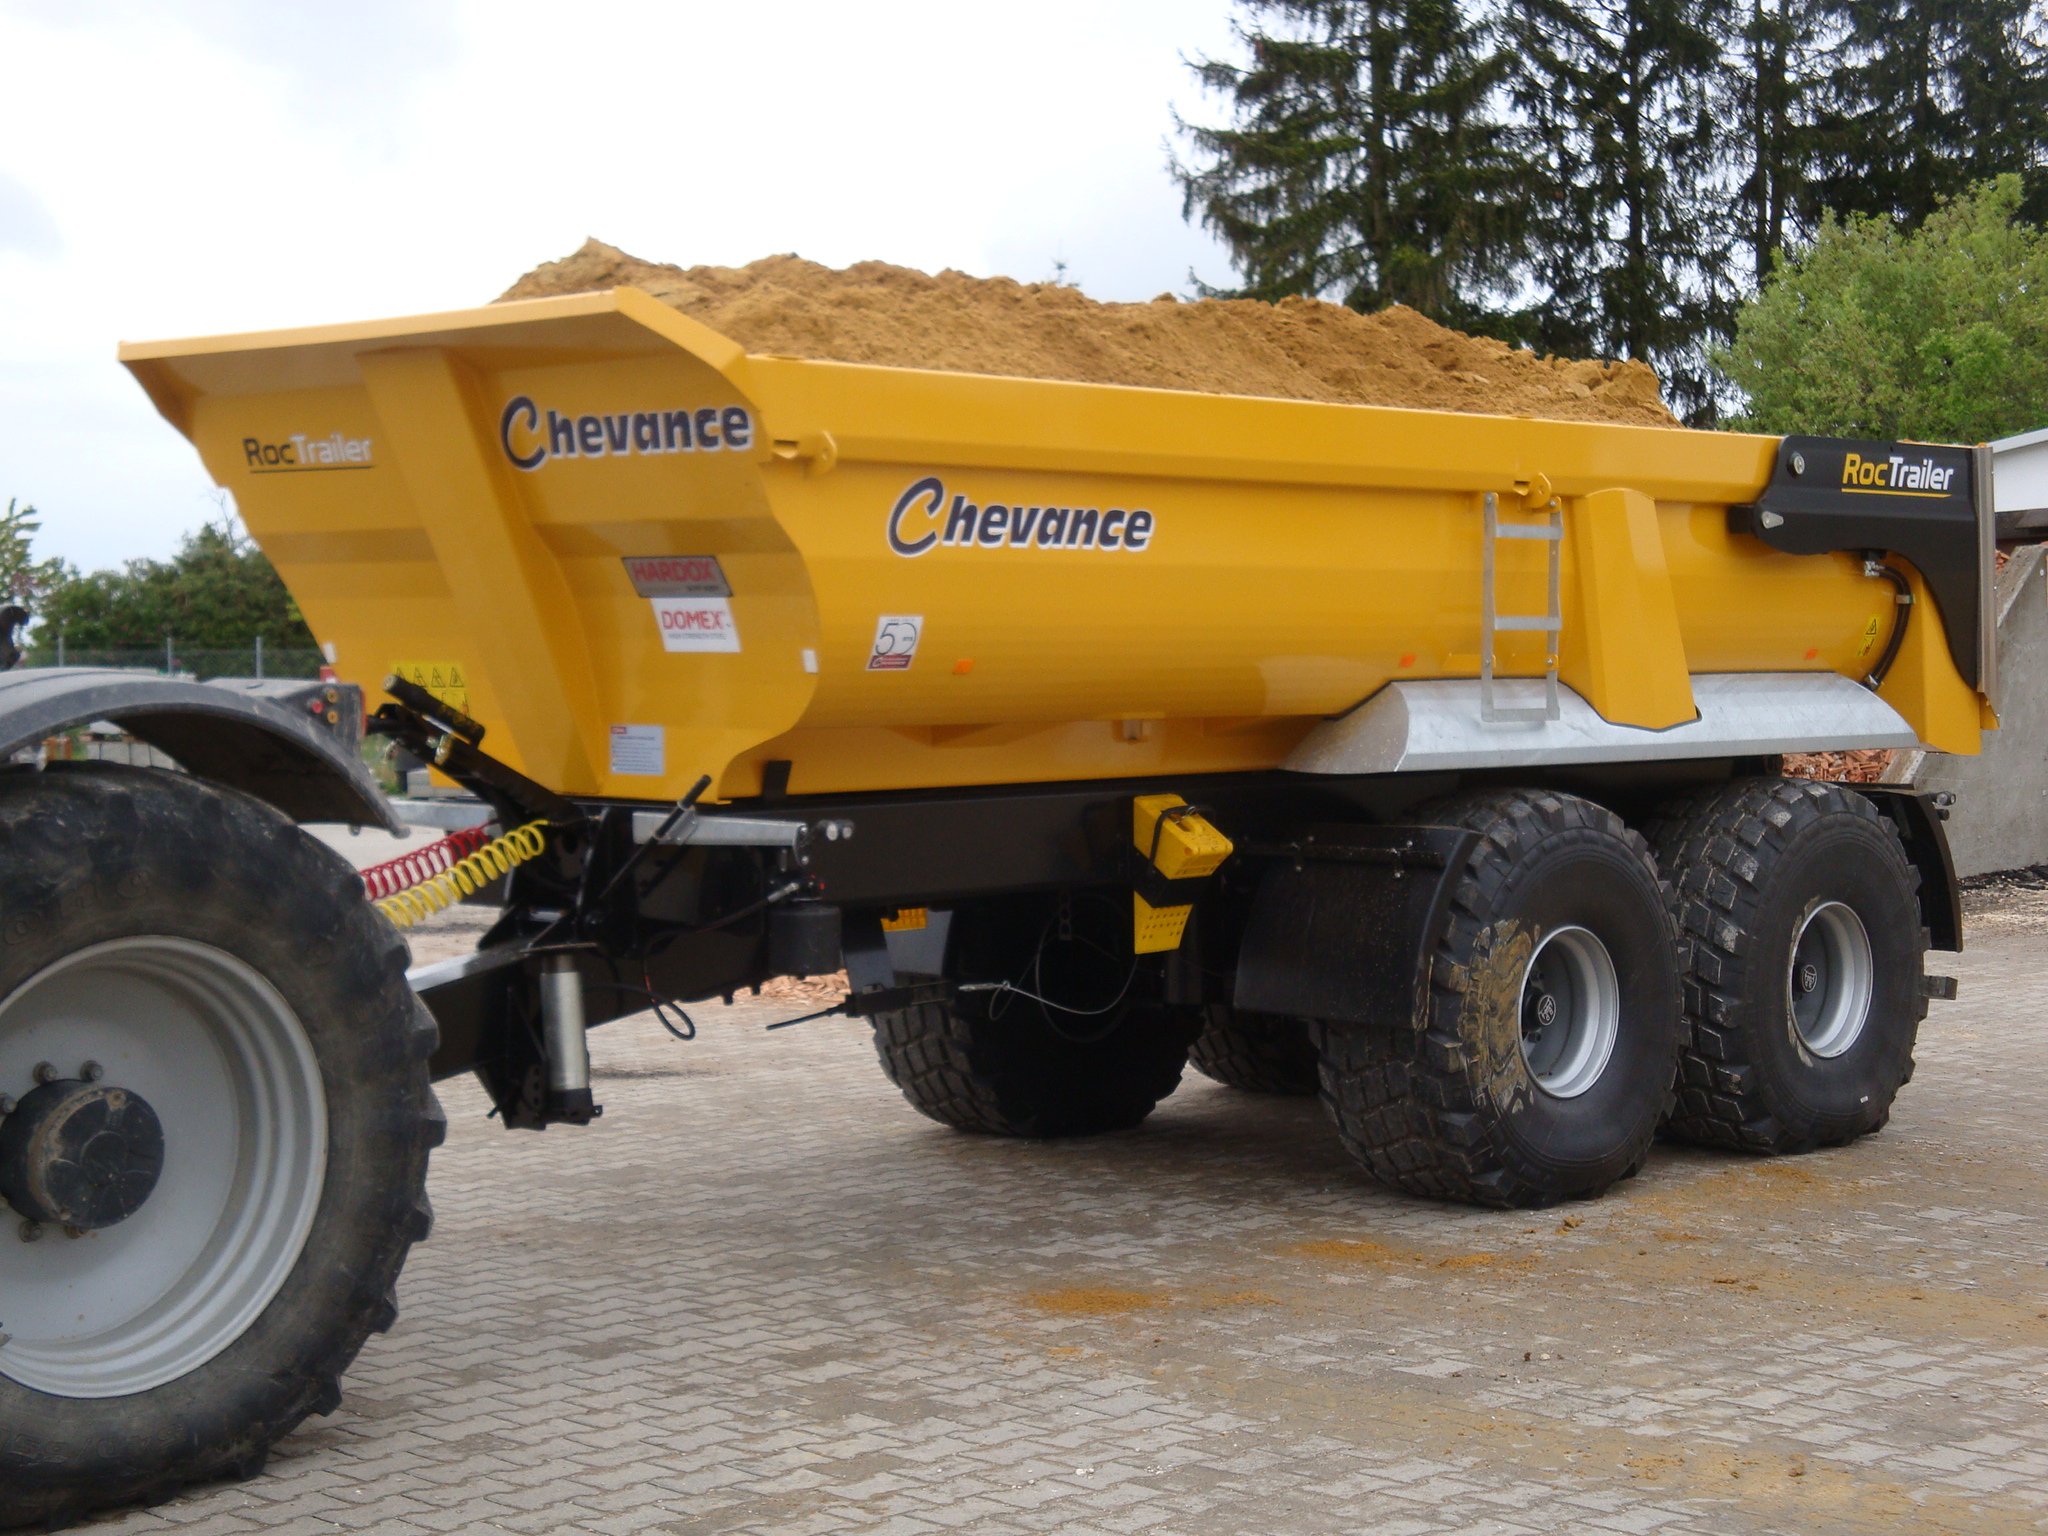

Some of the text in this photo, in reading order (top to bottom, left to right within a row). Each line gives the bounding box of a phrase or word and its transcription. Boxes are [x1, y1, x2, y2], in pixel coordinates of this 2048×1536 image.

[242, 433, 372, 466] RocTrailer
[501, 395, 753, 471] Chevance
[1842, 452, 1954, 490] RocTrailer
[887, 476, 1154, 558] Chevance
[631, 560, 717, 582] HARDOX
[660, 608, 725, 630] DOMEX
